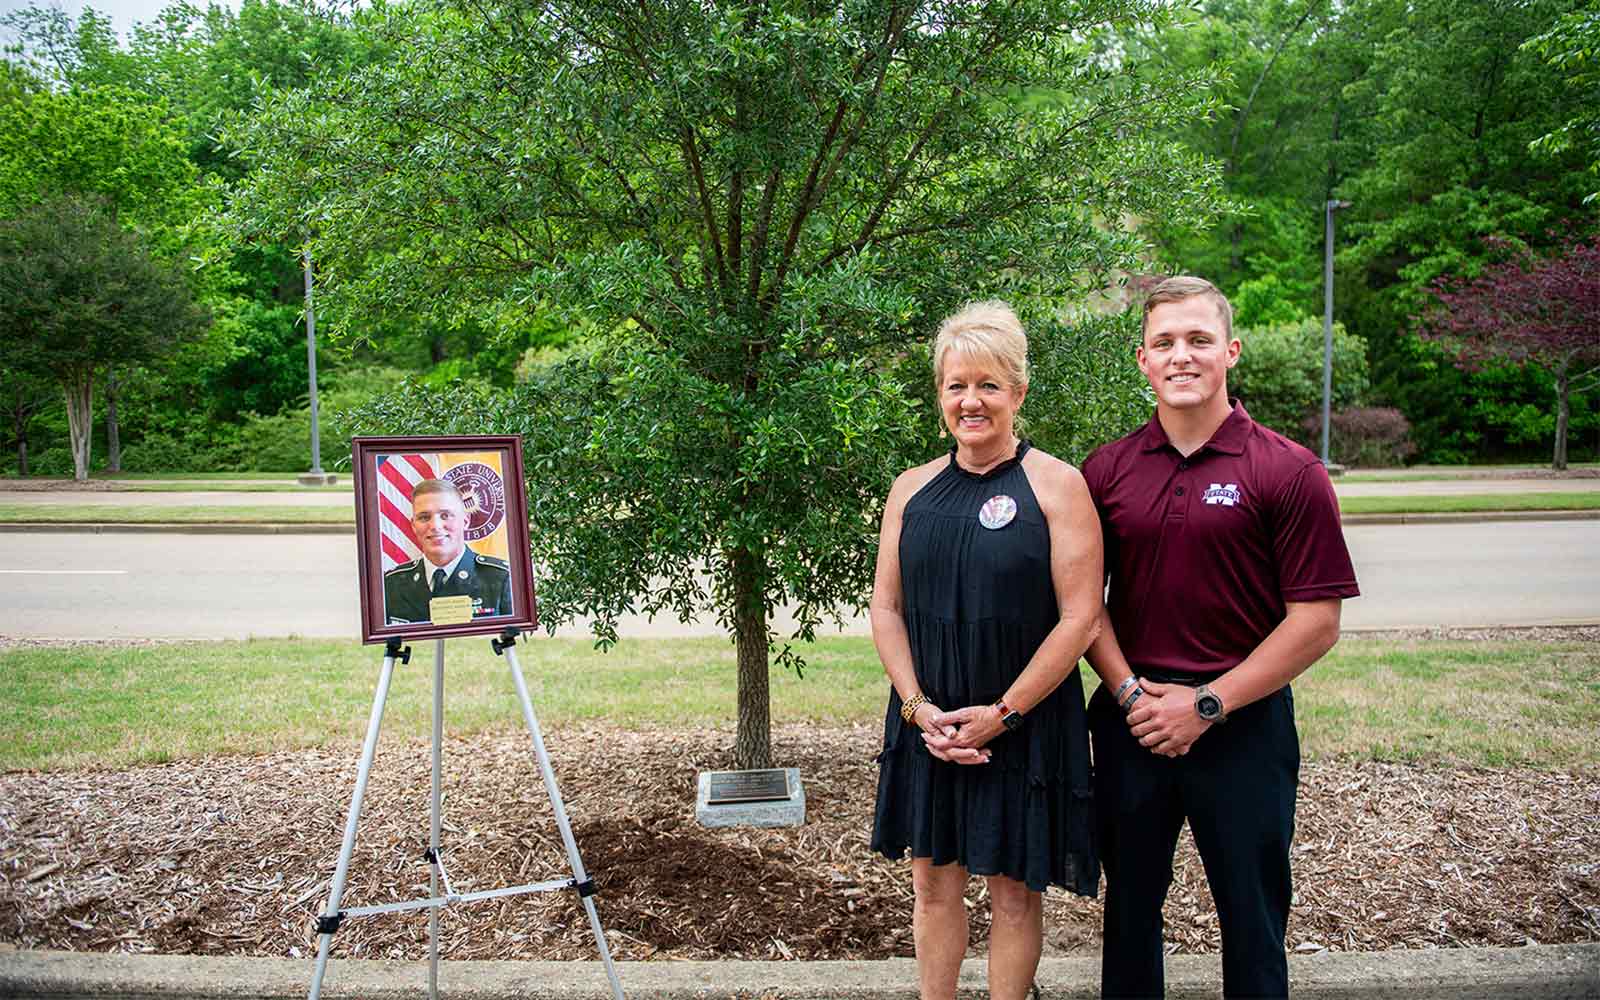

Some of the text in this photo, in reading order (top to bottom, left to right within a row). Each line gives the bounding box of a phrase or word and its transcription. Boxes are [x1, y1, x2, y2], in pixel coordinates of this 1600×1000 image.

[445, 464, 505, 513] STATE UNIVERSITY
[1208, 489, 1233, 499] STATE
[466, 522, 496, 540] 1878
